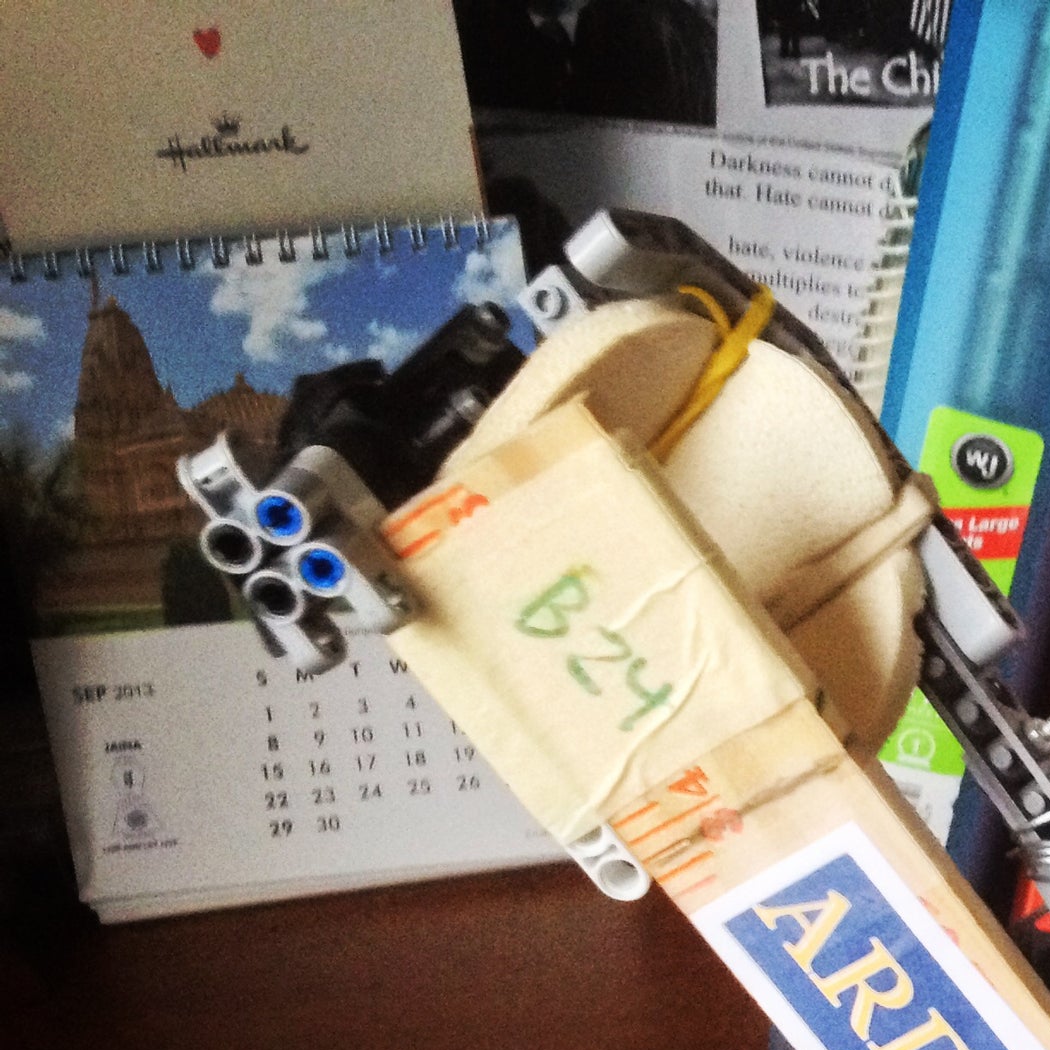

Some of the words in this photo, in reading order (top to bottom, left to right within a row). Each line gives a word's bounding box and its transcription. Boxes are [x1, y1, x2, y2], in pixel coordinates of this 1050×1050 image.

[801, 50, 871, 95] The
[156, 125, 310, 171] Hallmark
[710, 151, 800, 178] Darkness
[808, 168, 873, 189] cannot
[756, 185, 800, 208] Hate
[807, 197, 873, 217] cannot
[783, 248, 865, 271] violence
[968, 514, 1019, 534] Large
[389, 658, 408, 675] W
[72, 683, 106, 704] SEP
[113, 681, 155, 702] 2013
[265, 706, 273, 724] 1
[310, 702, 321, 719] 2
[358, 698, 370, 715] 3
[406, 695, 417, 711] 4
[267, 735, 279, 752] 8
[313, 731, 326, 749] 9
[352, 726, 374, 745] 10
[403, 721, 424, 738] 11
[261, 762, 284, 781] 15
[309, 758, 332, 777] 16
[355, 754, 377, 773] 17
[405, 749, 427, 768] 18
[454, 745, 475, 764] 19
[265, 791, 289, 811] 22
[312, 787, 336, 806] 23
[359, 782, 383, 801] 24
[408, 778, 431, 797] 25
[458, 774, 481, 793] 26
[269, 818, 294, 839] 29
[316, 814, 341, 834] 30
